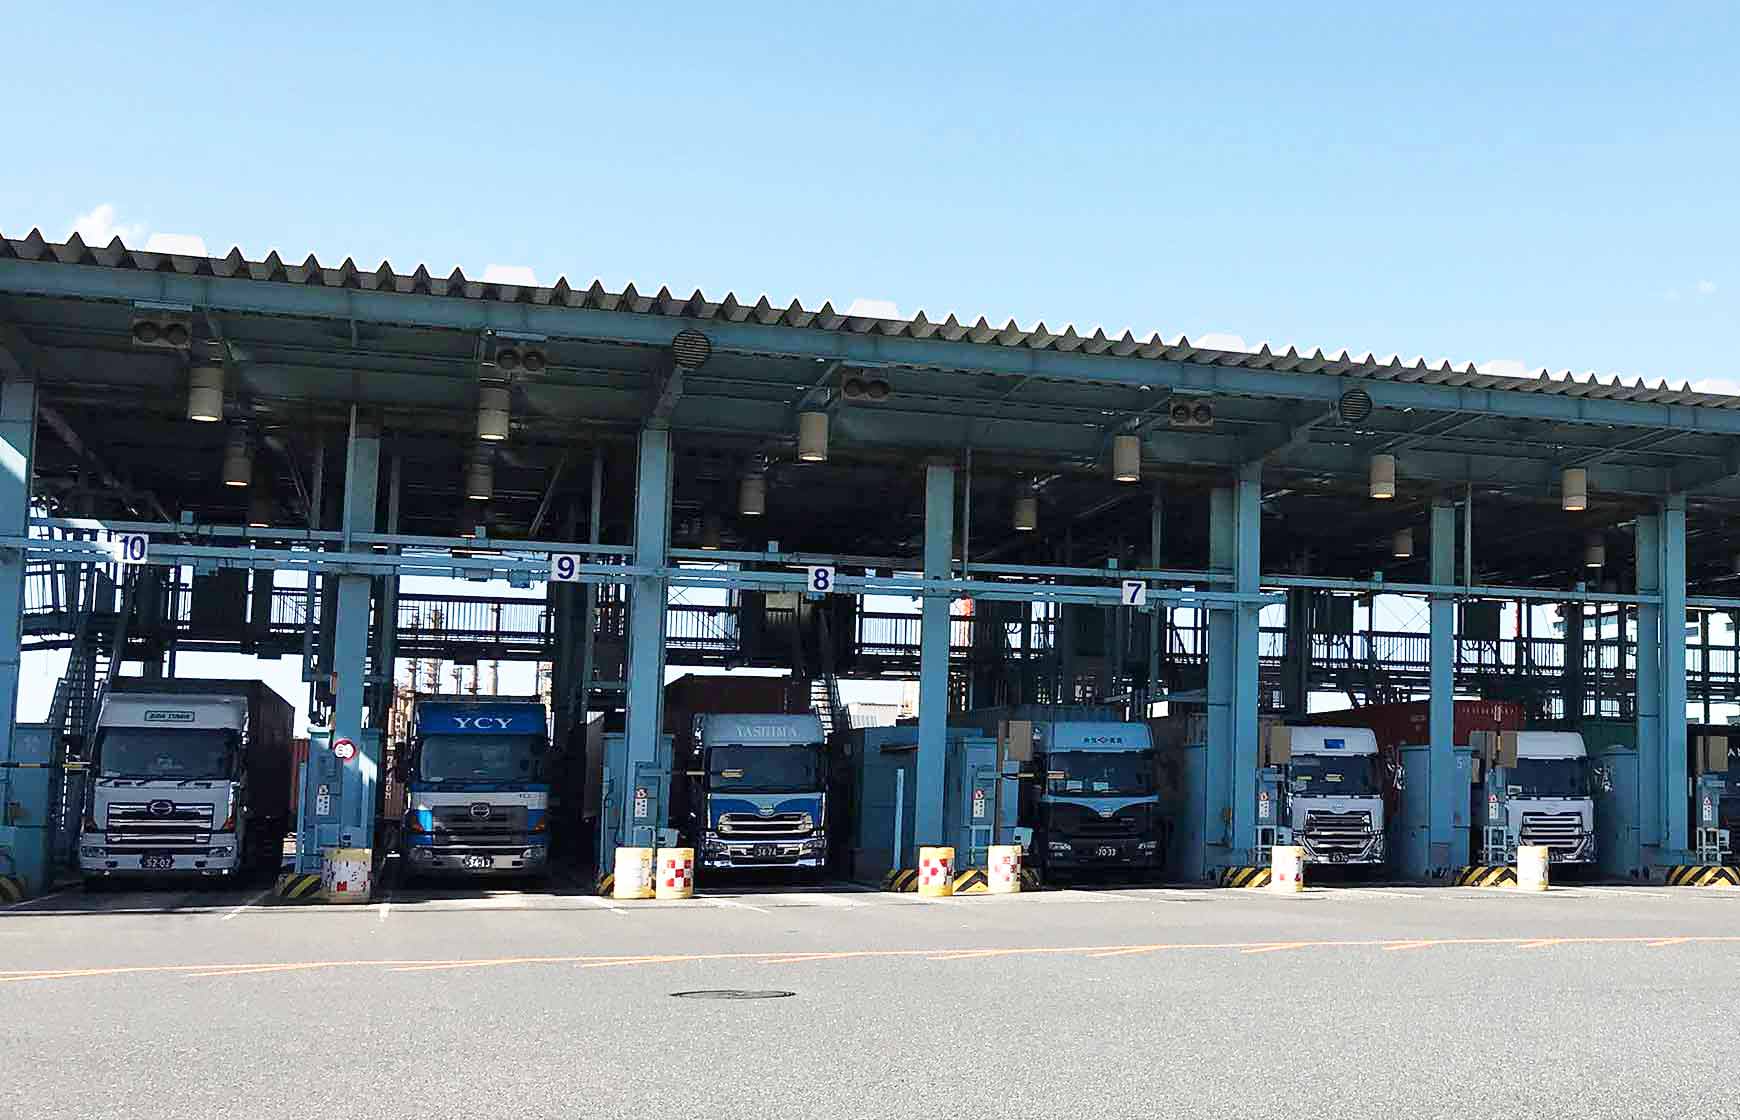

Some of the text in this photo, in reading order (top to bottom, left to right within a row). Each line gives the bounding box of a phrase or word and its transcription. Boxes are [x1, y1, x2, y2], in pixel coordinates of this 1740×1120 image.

[119, 535, 146, 560] 10
[557, 556, 575, 579] 9
[813, 568, 830, 591] 8
[1127, 582, 1142, 604] 7
[453, 717, 513, 729] YCY
[736, 727, 801, 737] YASHIMA
